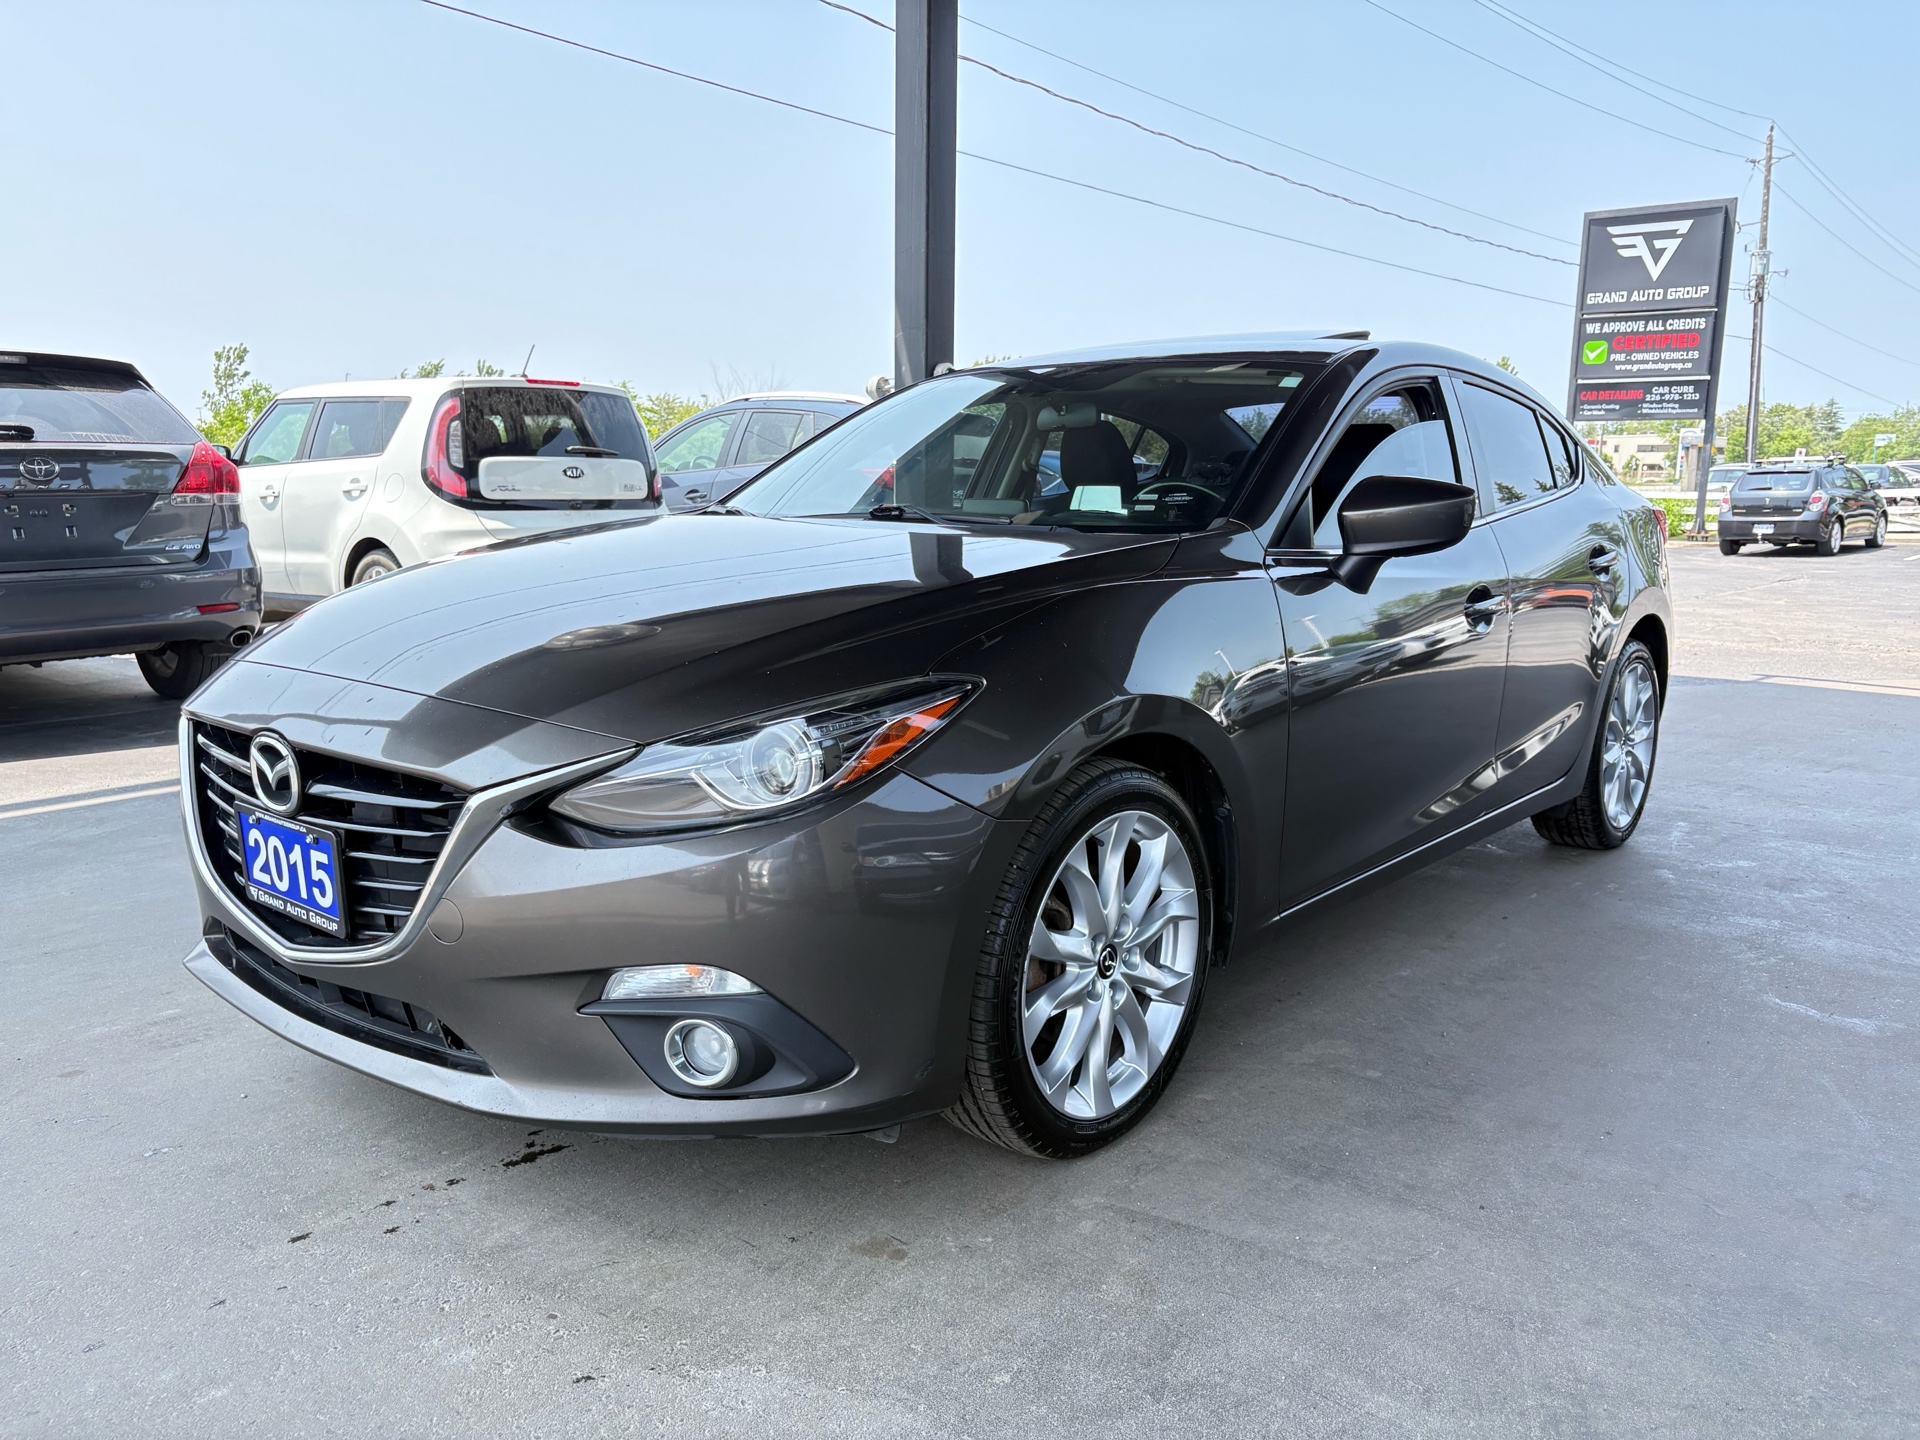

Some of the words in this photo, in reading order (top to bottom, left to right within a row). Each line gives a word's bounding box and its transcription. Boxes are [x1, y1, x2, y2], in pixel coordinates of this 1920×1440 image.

[1587, 291, 1627, 304] GRAND
[1630, 289, 1663, 301] AUTO
[1667, 286, 1709, 299] GROUP
[1586, 323, 1601, 334] WE
[1602, 321, 1645, 333] APPROVE
[1646, 320, 1664, 331] ALL
[1666, 318, 1706, 330] CREDITS
[1612, 333, 1700, 351] CERTIFIED
[1610, 353, 1626, 361] PRE
[1631, 352, 1660, 360] OWNED
[1661, 351, 1699, 359] VEHICLES
[1580, 391, 1597, 401] CAR
[1599, 390, 1643, 400] DETAILING
[564, 467, 584, 478] KIA
[248, 828, 333, 908] 2015
[258, 889, 284, 910] GRAND
[286, 903, 307, 919] AUTO
[309, 912, 338, 932] GROUP
